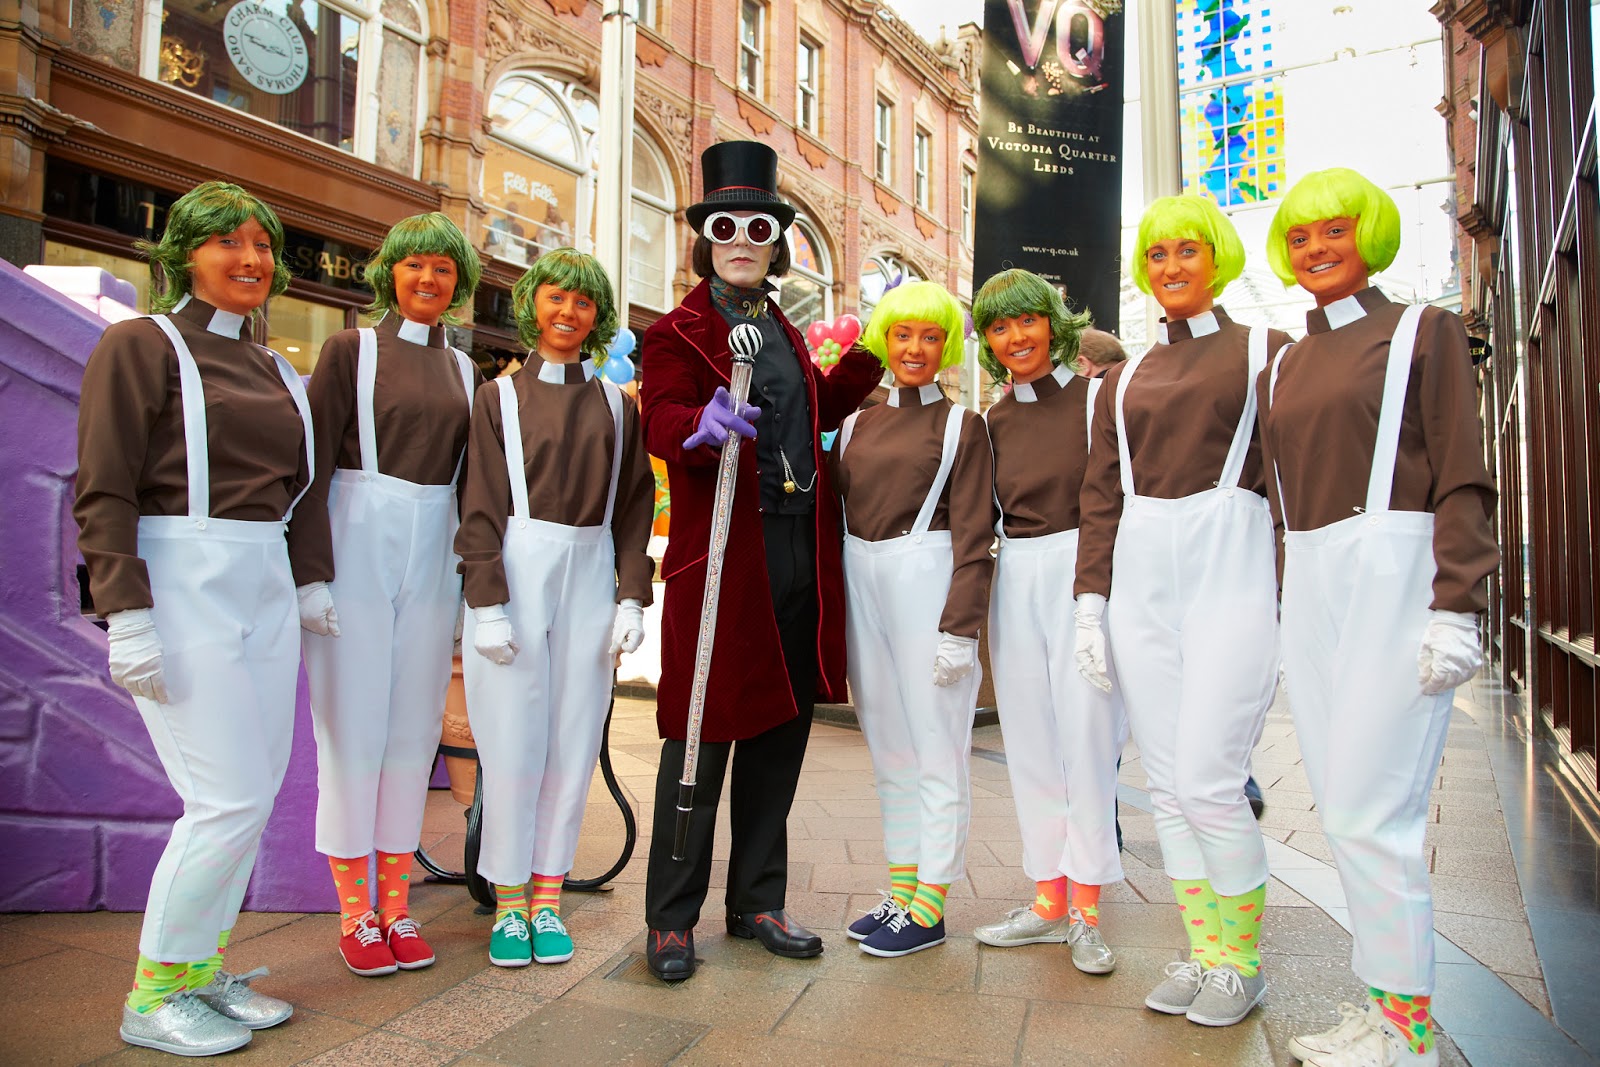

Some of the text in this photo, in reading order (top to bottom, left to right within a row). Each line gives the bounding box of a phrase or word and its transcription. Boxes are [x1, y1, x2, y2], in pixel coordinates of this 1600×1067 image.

[230, 3, 274, 27] CHARM
[279, 17, 304, 55] CLUB
[228, 35, 253, 76] SABO
[256, 63, 304, 90] THOMAS
[1022, 245, 1079, 257] www.v-q.co.uk
